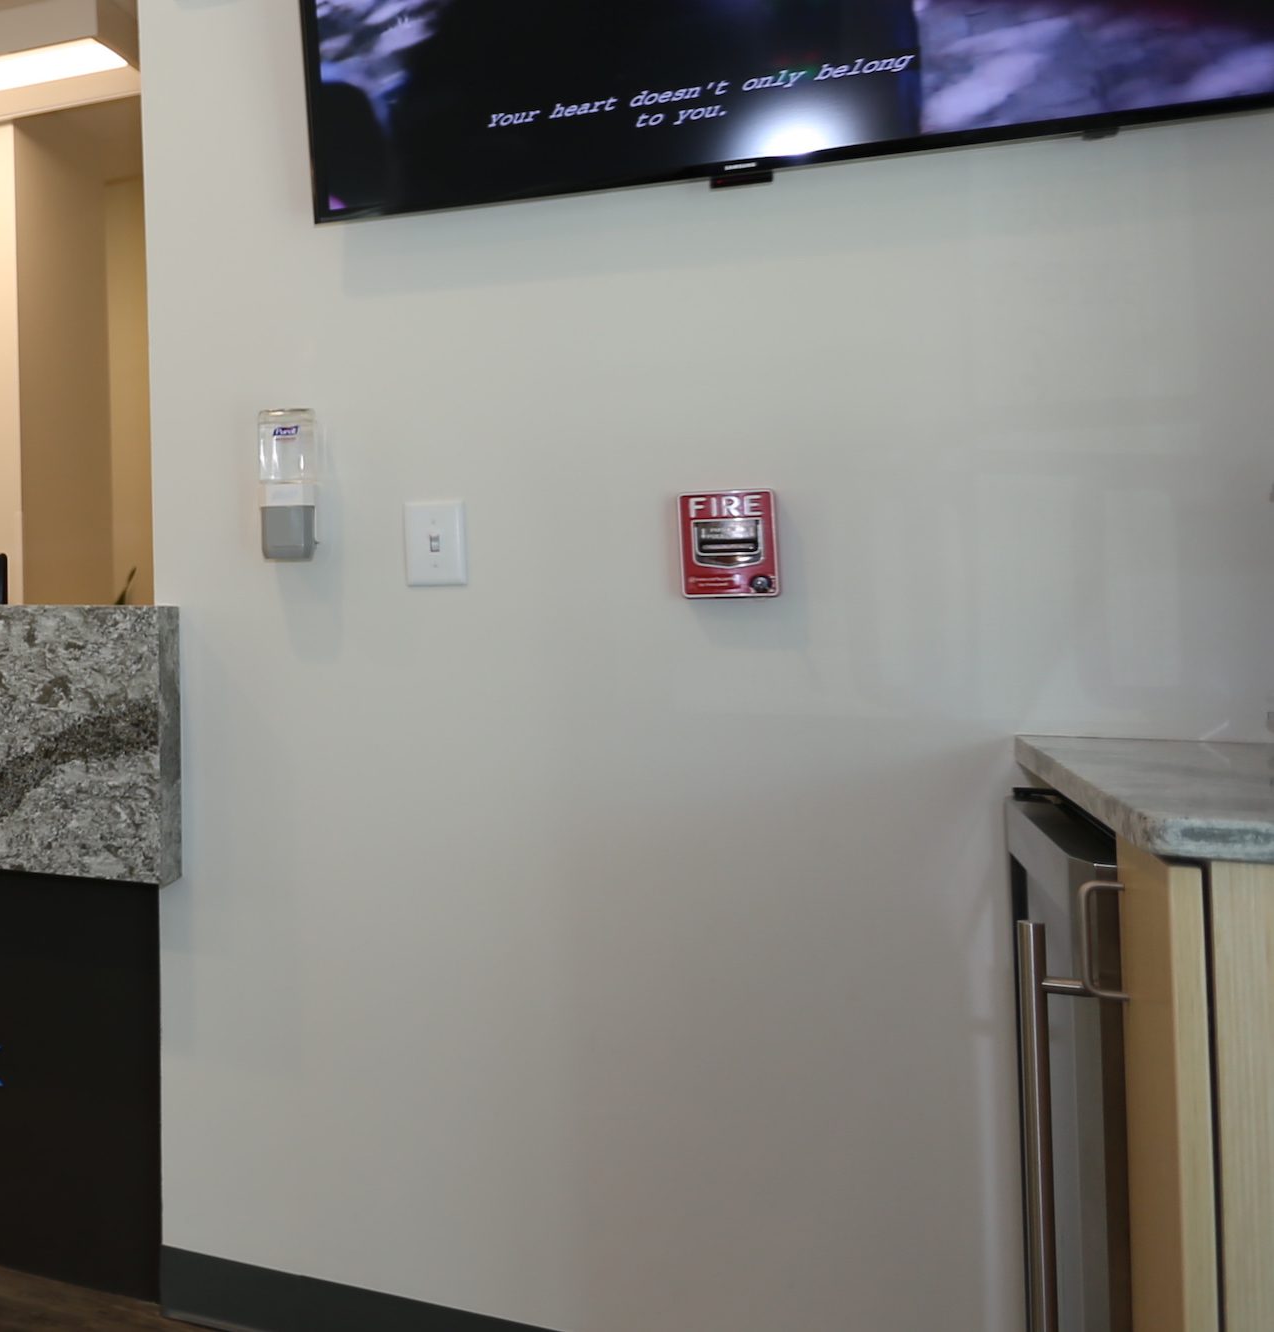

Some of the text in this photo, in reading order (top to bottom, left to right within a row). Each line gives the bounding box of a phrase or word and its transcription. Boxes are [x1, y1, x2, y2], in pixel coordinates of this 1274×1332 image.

[487, 54, 915, 128] Your heart doesn't only belong
[635, 104, 728, 128] to you.
[687, 494, 765, 519] FIRE
